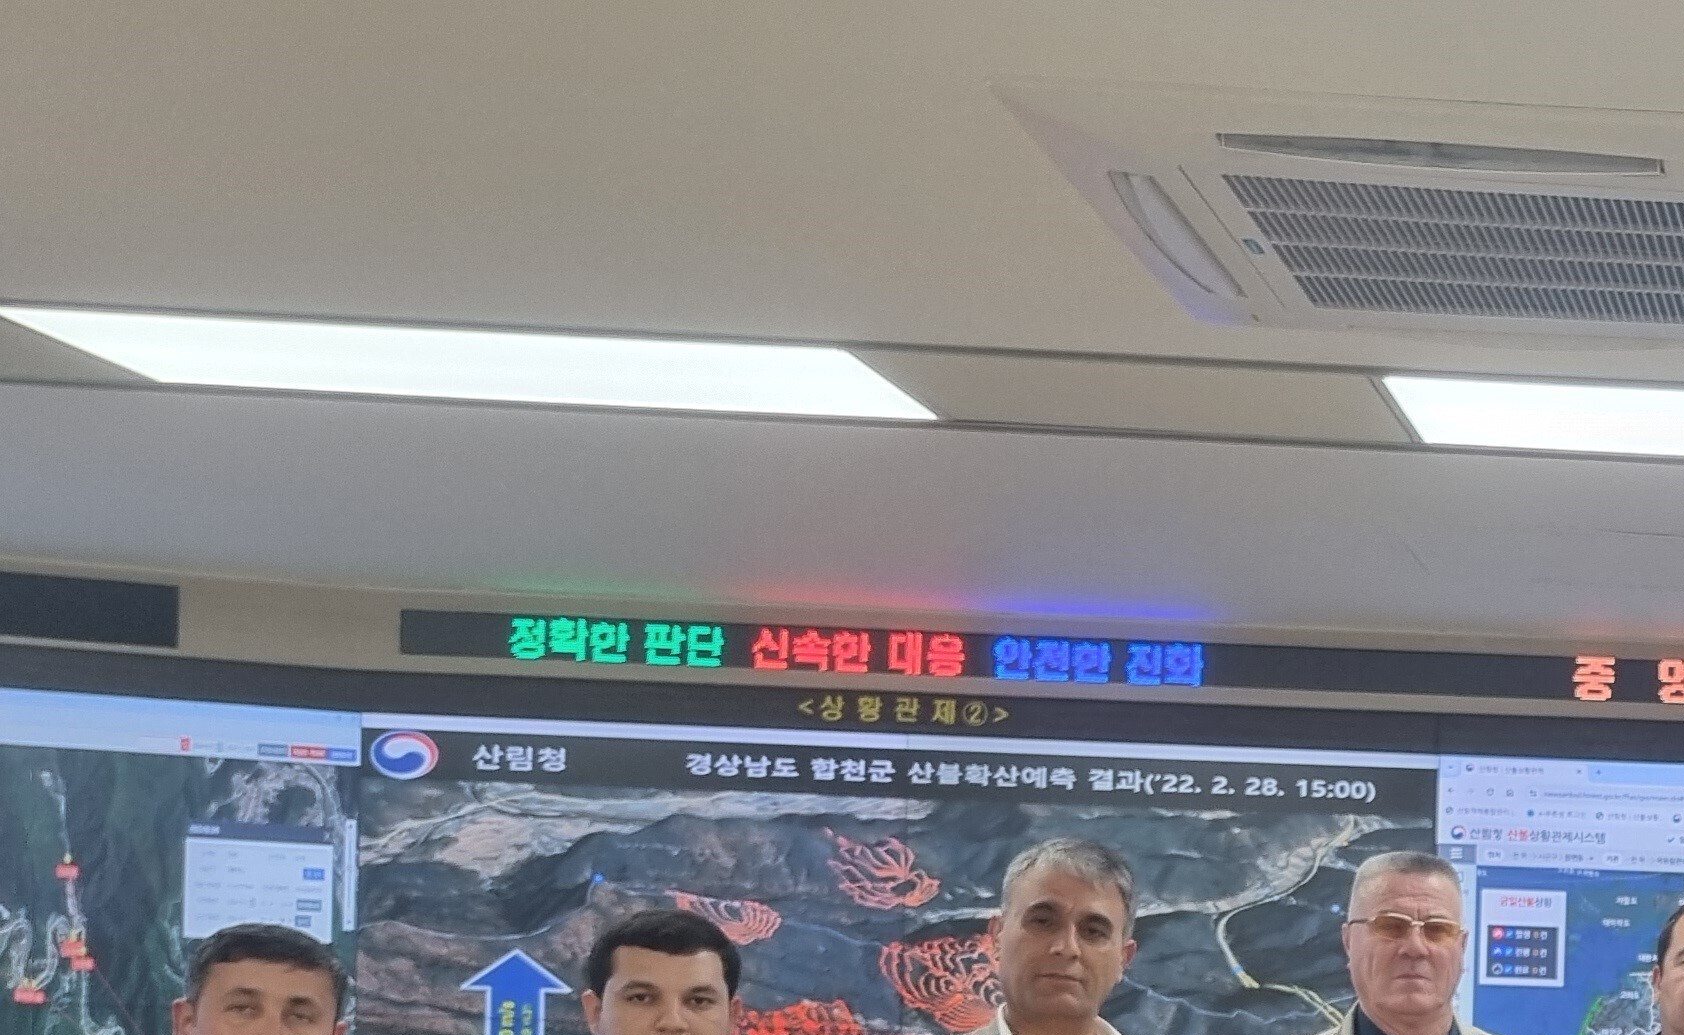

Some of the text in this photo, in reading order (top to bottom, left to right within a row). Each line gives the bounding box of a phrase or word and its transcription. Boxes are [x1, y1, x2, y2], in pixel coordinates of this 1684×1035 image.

[509, 617, 1204, 687] 정확한 판단 신속한 대응 안전한 진화
[472, 743, 568, 773] 산림청
[686, 752, 799, 779] 경상남도
[810, 757, 896, 783] 합천군
[907, 761, 1075, 790] 산불확산예측
[1245, 777, 1285, 797] 28.
[1295, 778, 1376, 803] 15:00)
